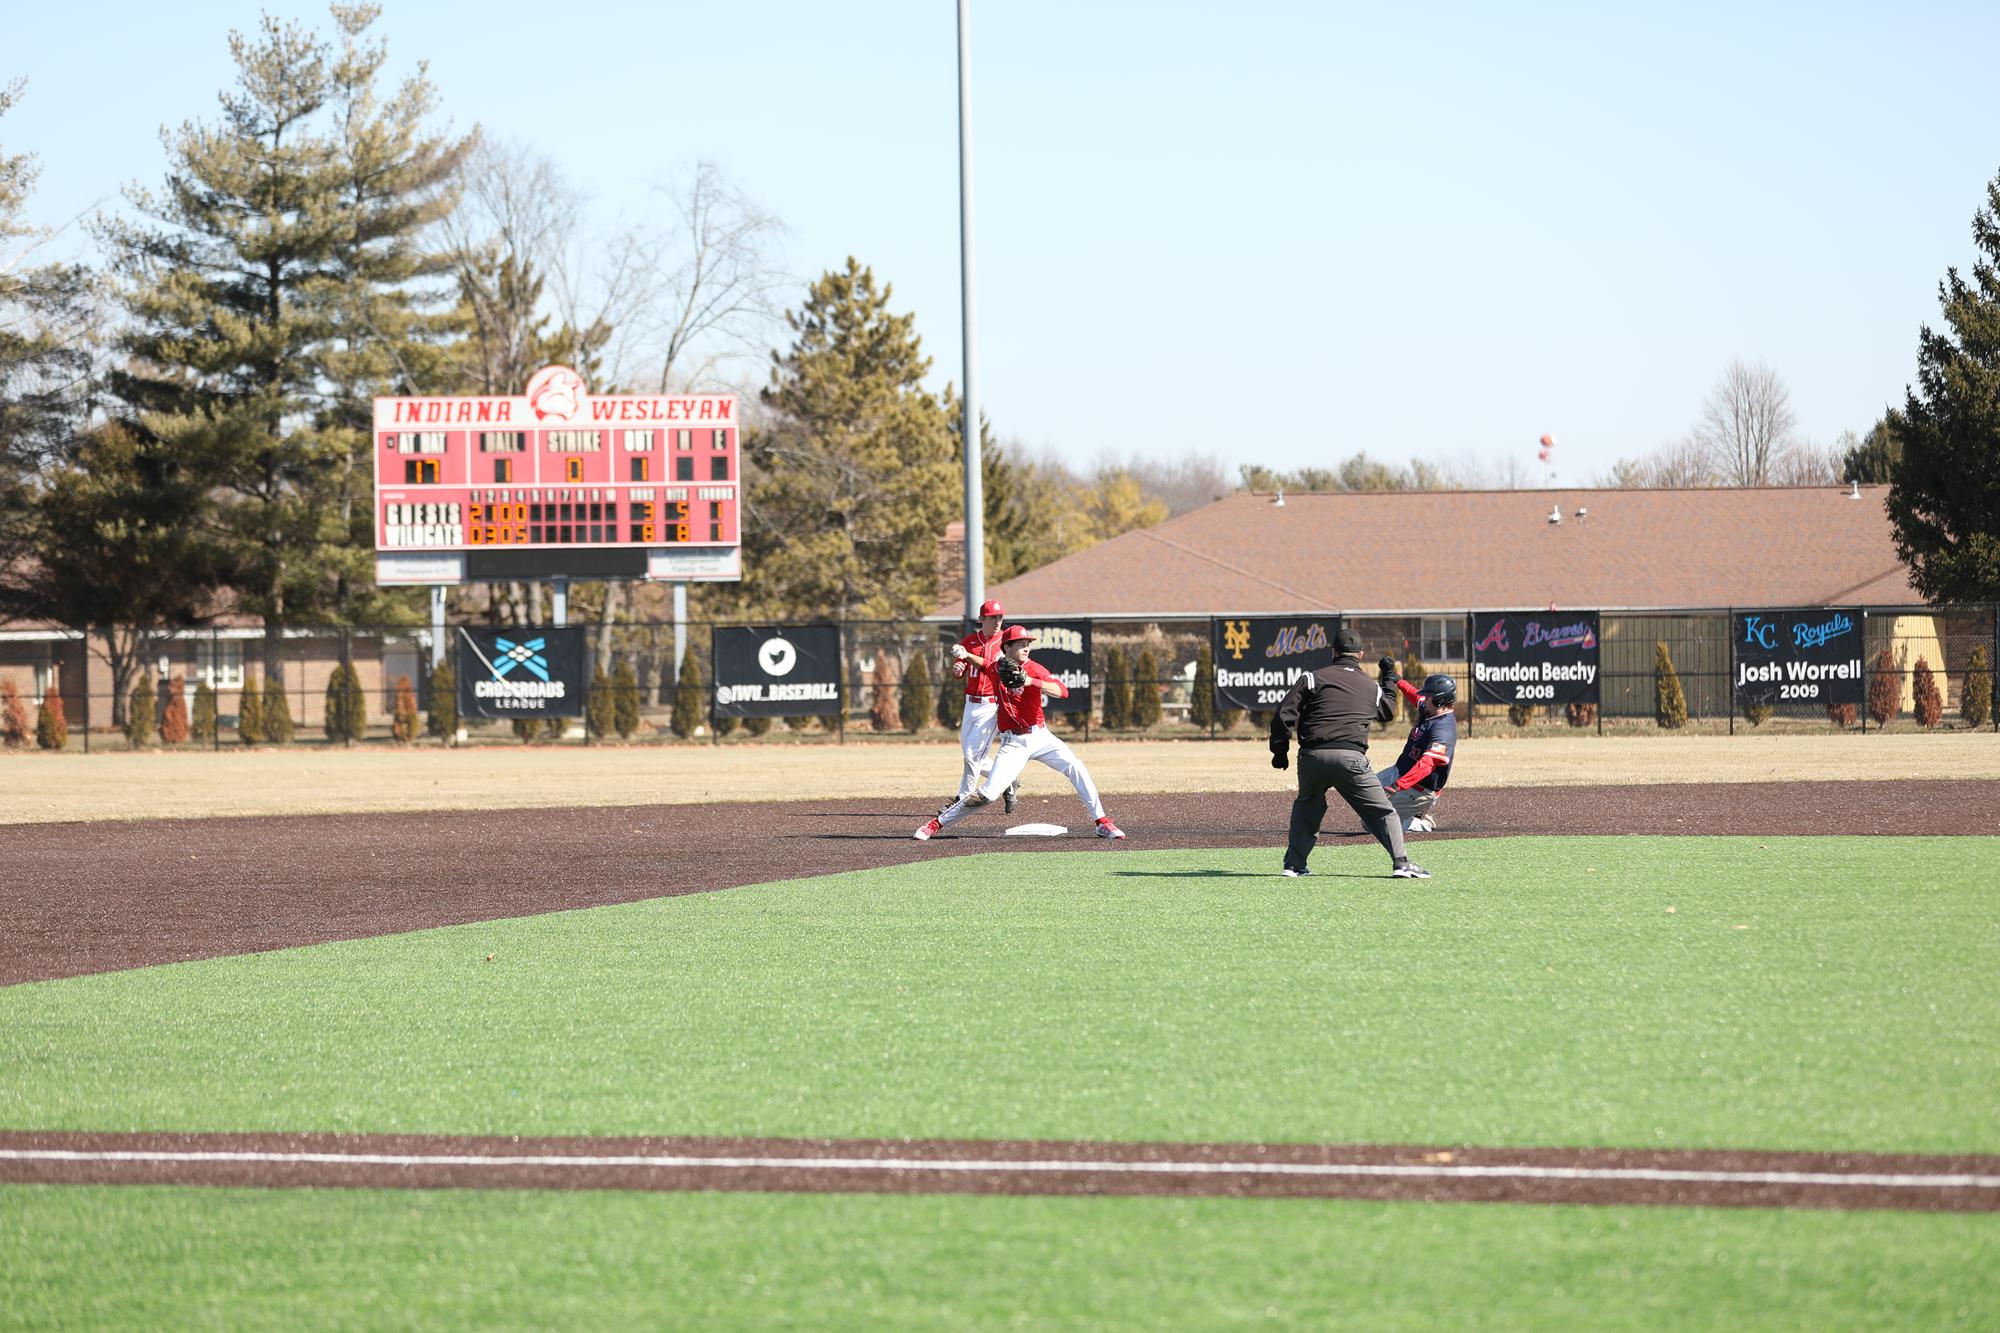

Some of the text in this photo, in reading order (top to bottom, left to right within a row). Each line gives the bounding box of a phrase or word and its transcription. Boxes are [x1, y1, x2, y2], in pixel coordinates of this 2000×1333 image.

[394, 400, 732, 422] INDIANA WESLEYAN
[549, 430, 601, 452] STRIKE
[624, 430, 654, 452] OUT
[566, 458, 583, 482] 0
[387, 503, 461, 525] GUESTS
[385, 524, 463, 546] WILDCATS
[1265, 623, 1328, 657] Mets
[1523, 622, 1584, 648] Braves
[1744, 614, 1852, 649] KC Royals
[1056, 669, 1090, 688] dale
[1217, 667, 1284, 687] Brandon
[1475, 661, 1596, 684] Brandon Beachy
[1738, 660, 1861, 686] Josh Worrell
[1257, 689, 1290, 703] 200
[1515, 685, 1554, 699] 2008
[1780, 684, 1819, 699] 2009
[495, 698, 545, 709] LEAGUE
